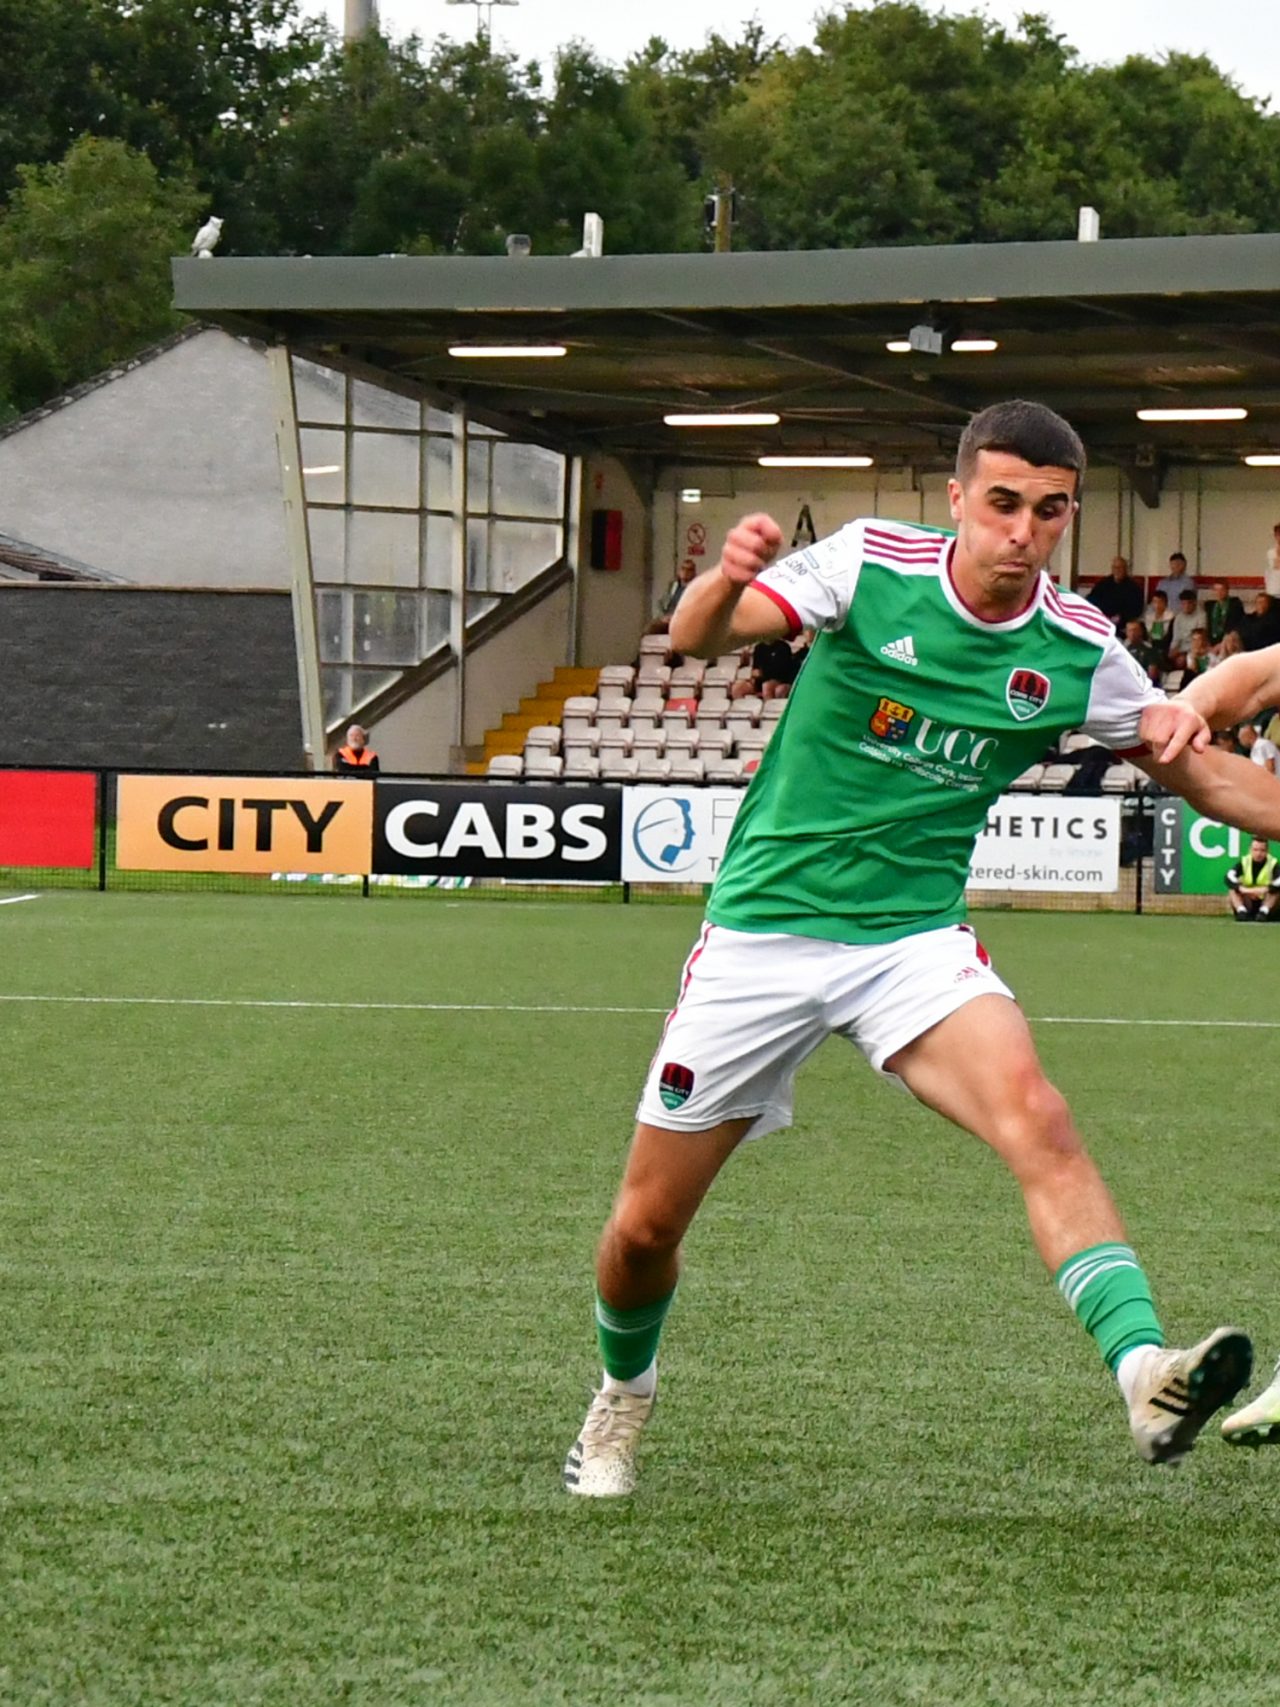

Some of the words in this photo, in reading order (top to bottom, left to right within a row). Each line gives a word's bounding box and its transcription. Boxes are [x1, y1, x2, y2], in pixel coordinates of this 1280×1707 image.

[791, 504, 817, 547] A
[880, 646, 918, 666] adidas
[914, 715, 1000, 771] UCC
[157, 797, 343, 853] CITY
[385, 801, 607, 861] CABS
[1160, 807, 1177, 886] CITY
